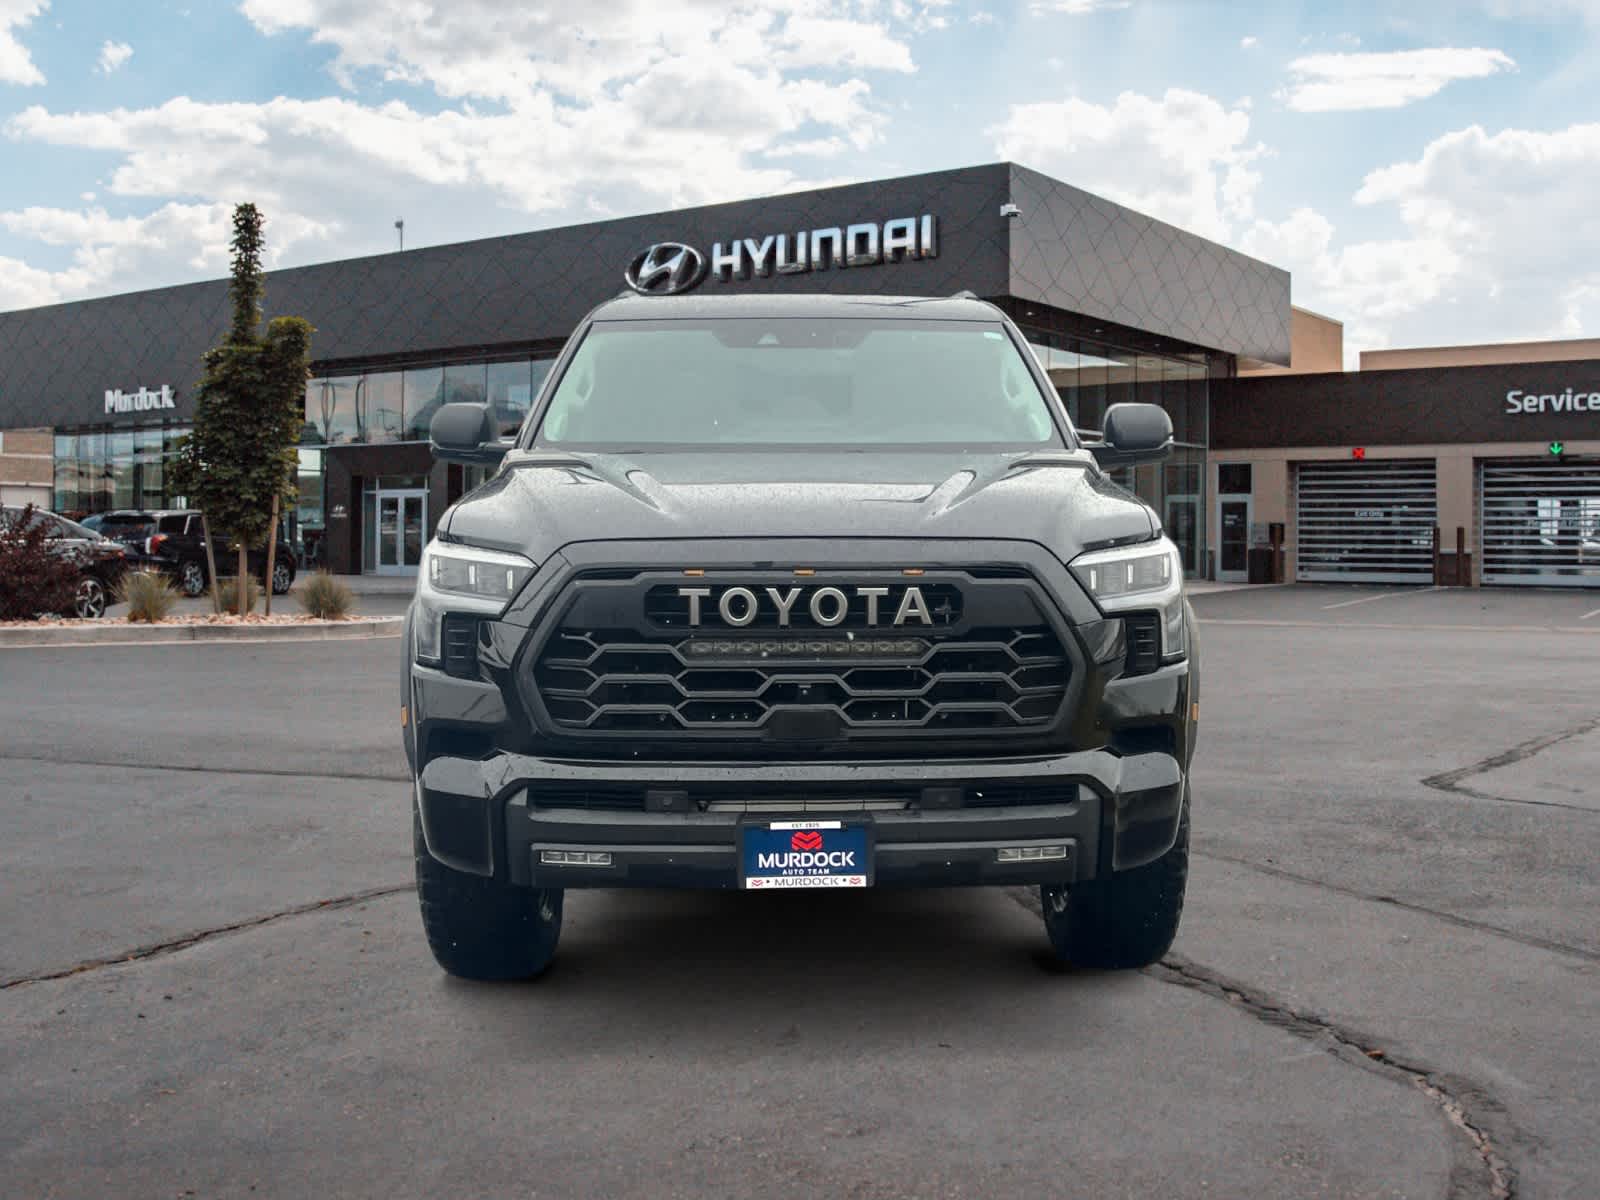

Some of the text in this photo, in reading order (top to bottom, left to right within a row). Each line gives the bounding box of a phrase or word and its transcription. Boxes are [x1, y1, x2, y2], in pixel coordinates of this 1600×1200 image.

[712, 214, 937, 283] HYUNDAI
[104, 384, 176, 414] Murdock
[1505, 387, 1600, 414] Service
[678, 586, 933, 627] TOYOTA
[758, 851, 855, 869] MURDOCK
[782, 868, 804, 876] AUTO
[774, 876, 839, 887] MURDOCK
